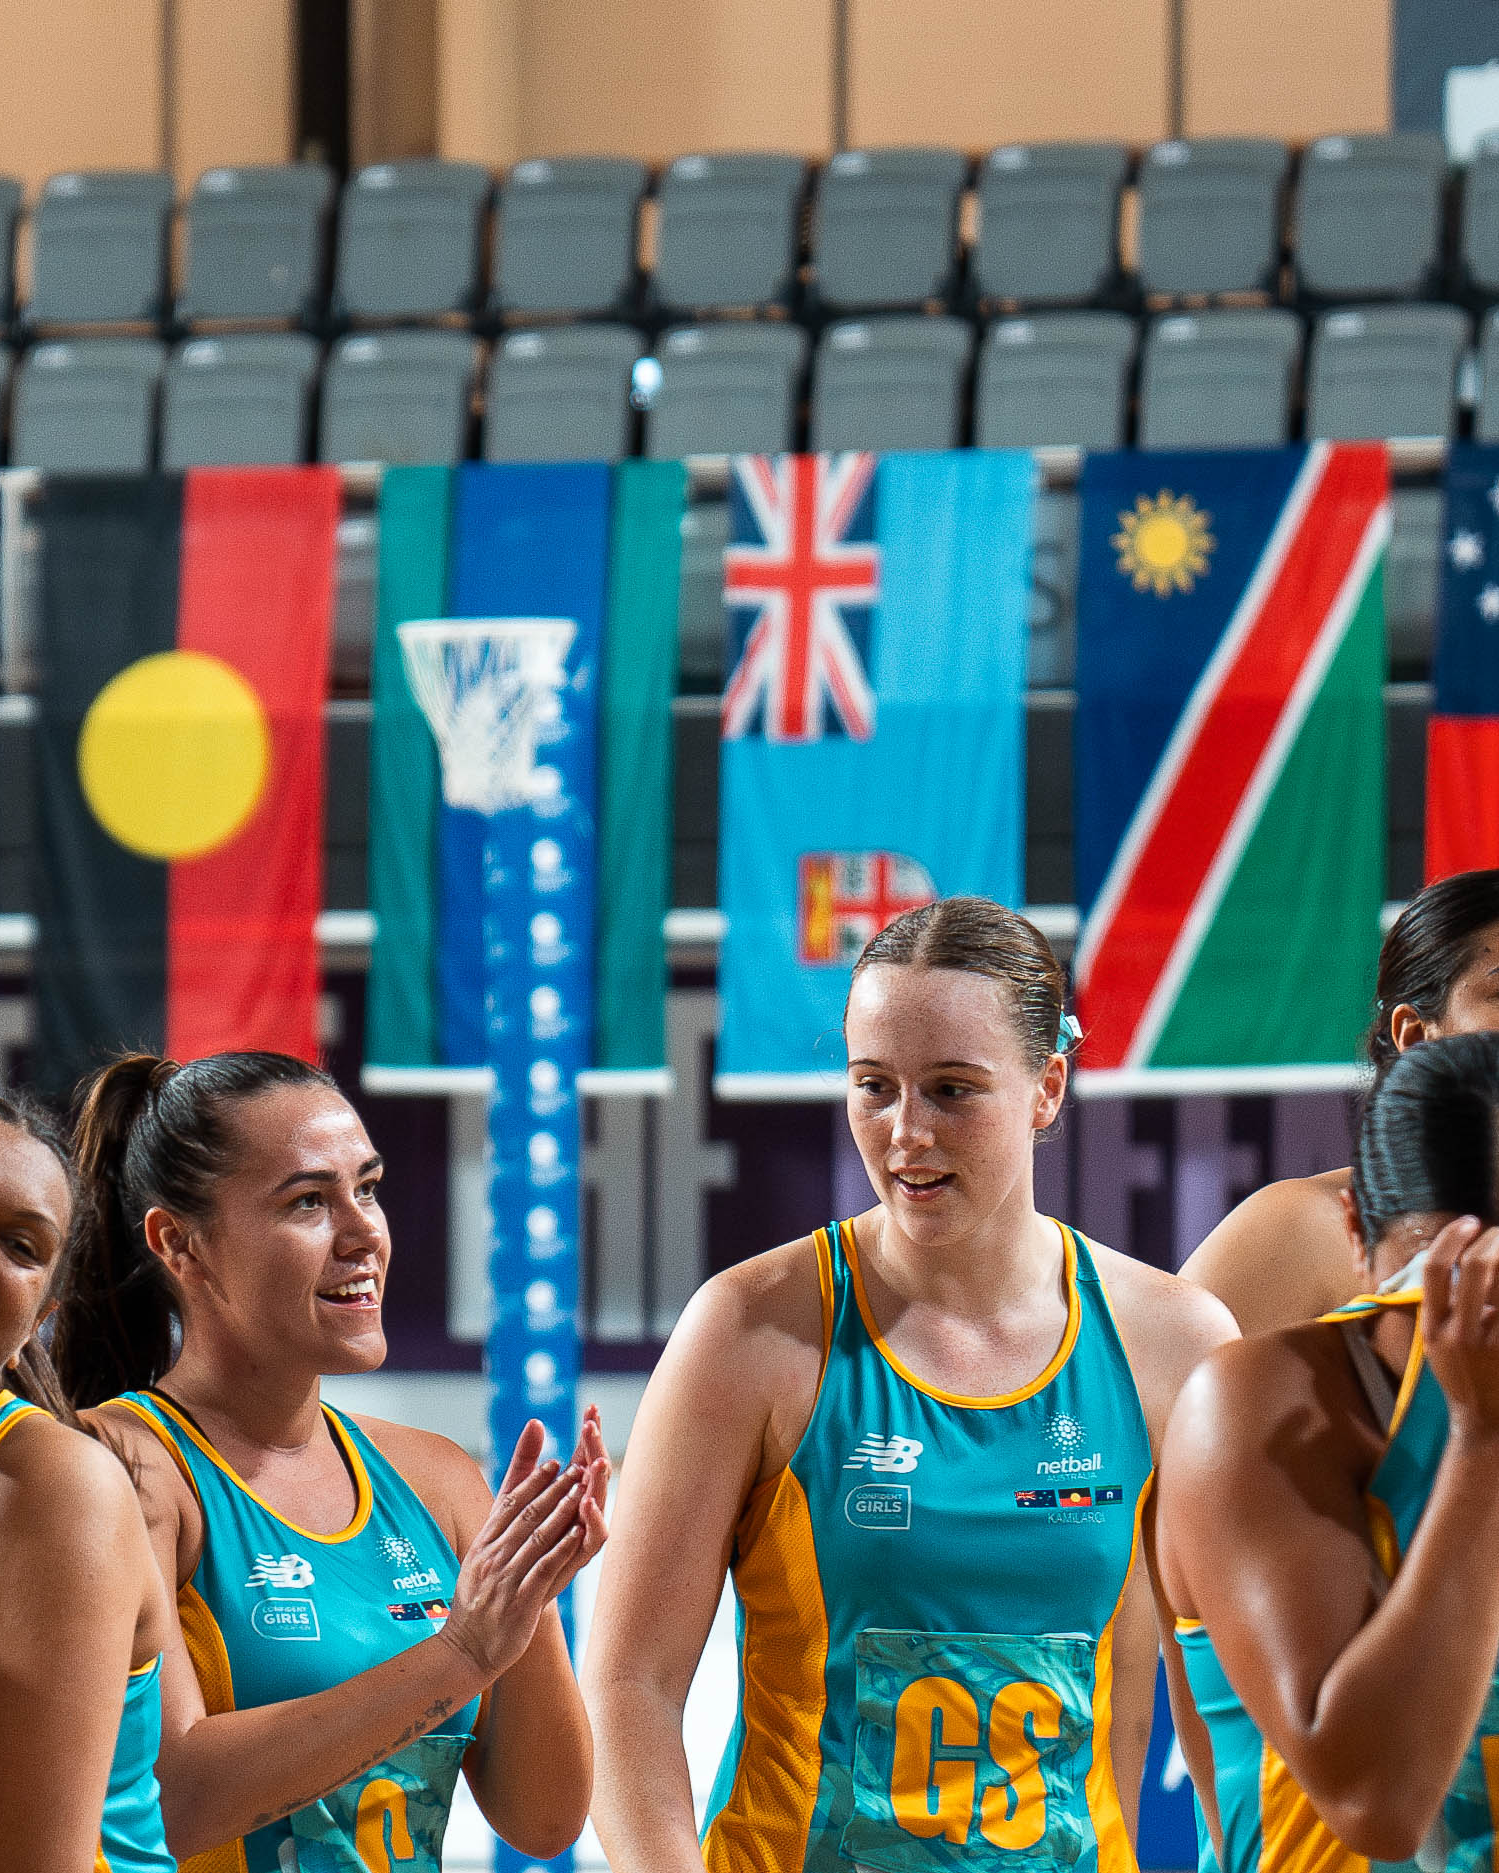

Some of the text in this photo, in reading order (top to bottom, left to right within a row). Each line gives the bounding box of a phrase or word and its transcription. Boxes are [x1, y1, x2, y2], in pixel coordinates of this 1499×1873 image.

[1036, 1452, 1104, 1476] netball
[855, 1500, 903, 1514] GIRLS
[263, 1612, 310, 1626] GIRLS
[891, 1676, 1062, 1850] GS
